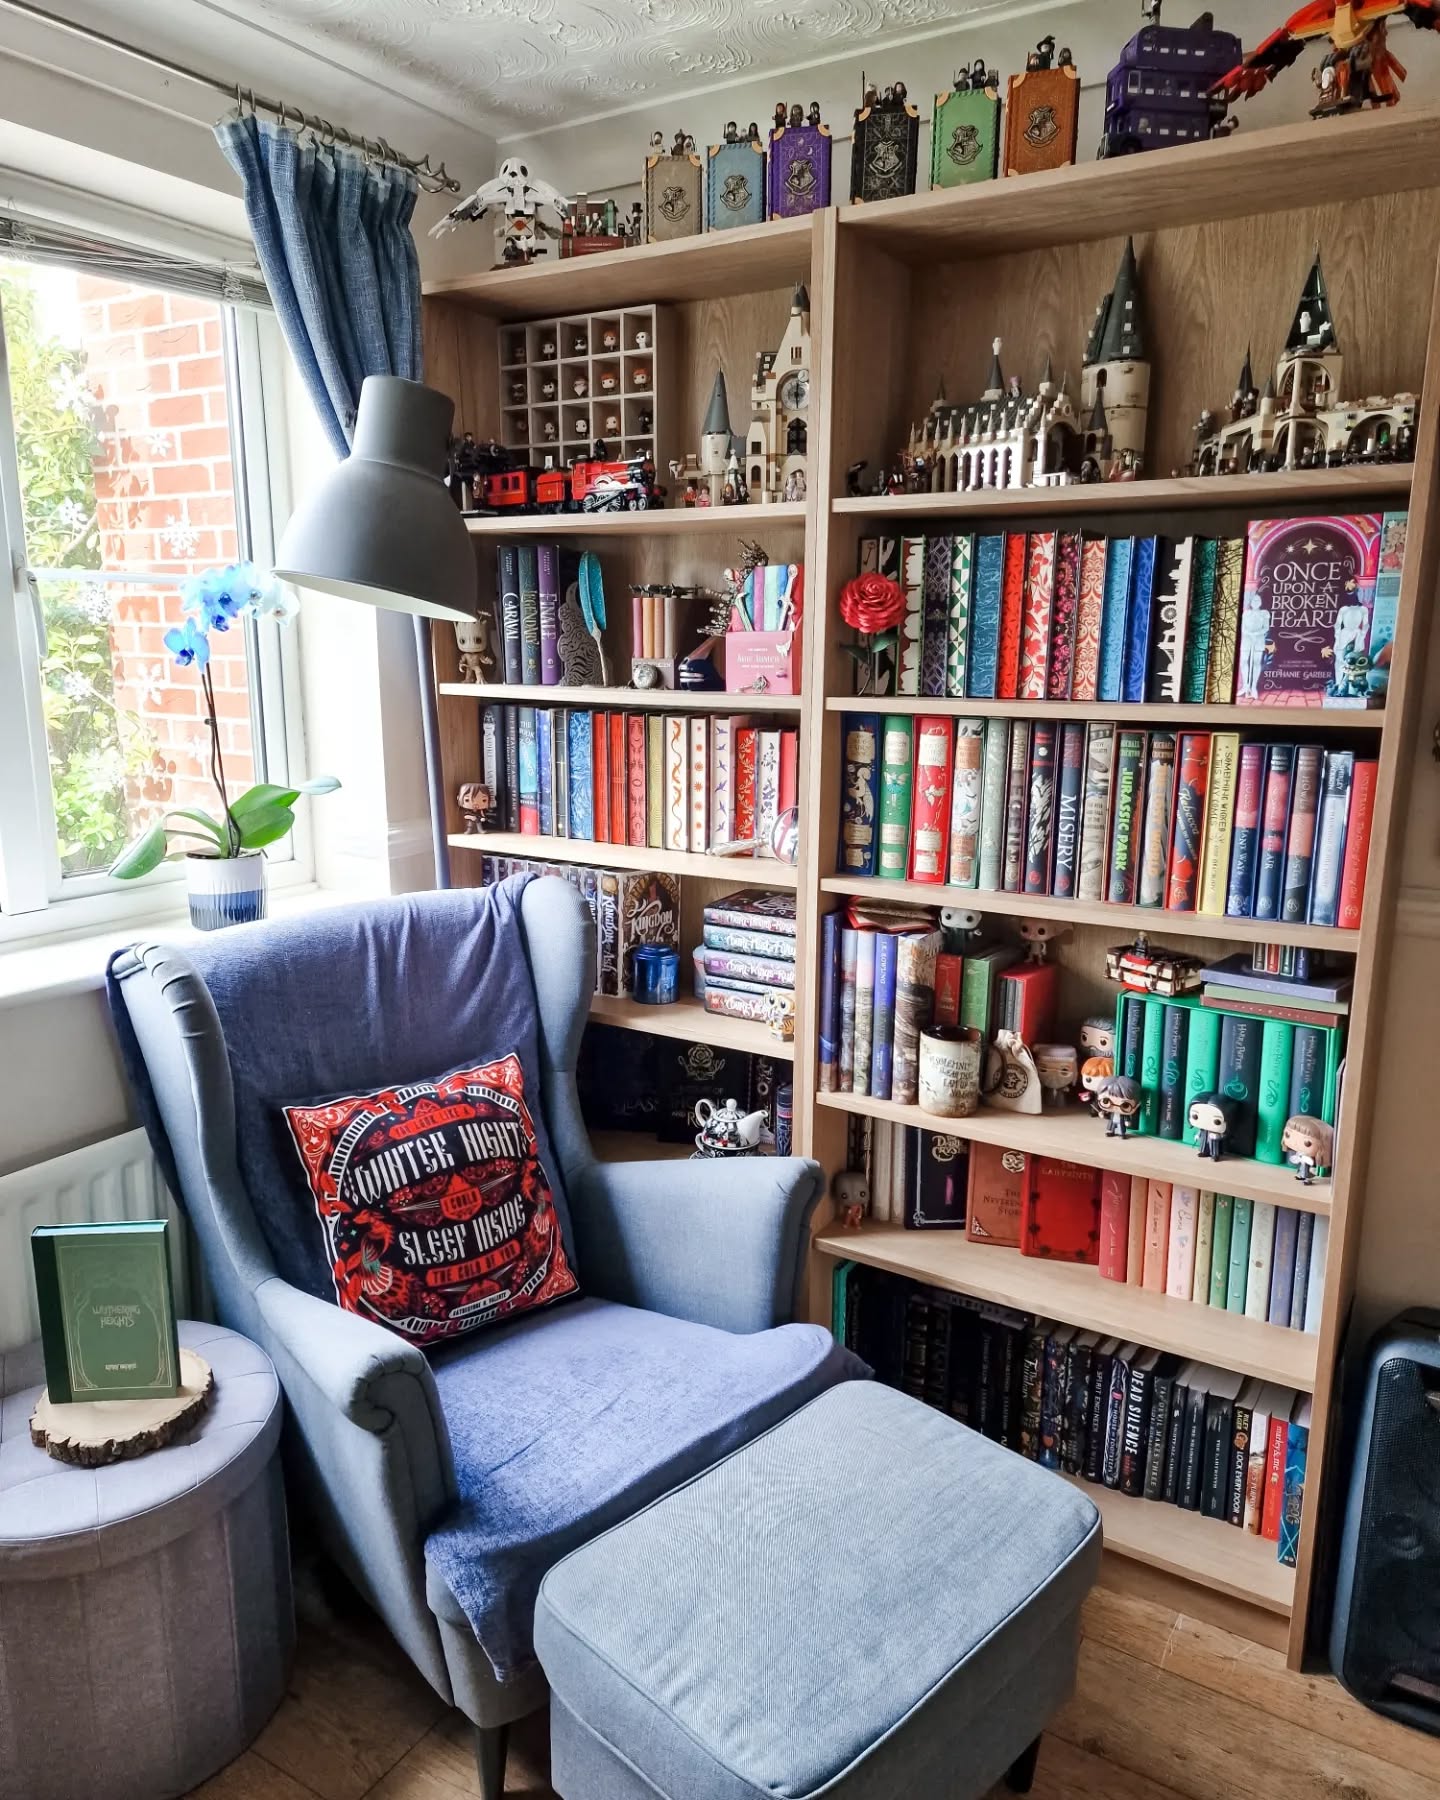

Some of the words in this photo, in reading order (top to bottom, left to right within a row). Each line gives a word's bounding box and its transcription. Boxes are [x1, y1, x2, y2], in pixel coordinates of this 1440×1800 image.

[1274, 562, 1342, 581] ONCE
[1273, 582, 1316, 594] UPON
[1320, 582, 1338, 593] A
[539, 590, 557, 640] FINALE
[1271, 594, 1339, 612] BROKEN
[502, 592, 519, 642] CARAVAL
[521, 591, 540, 645] LEGENDARY
[1270, 610, 1338, 628] HEART
[1264, 669, 1300, 678] STEPHANIE
[1303, 671, 1332, 679] GARBER
[1222, 752, 1233, 801] SOMETHING
[1118, 767, 1133, 831] JURASSIC
[1179, 787, 1199, 835] Rebecca
[1057, 795, 1076, 870] MISERY
[1115, 834, 1129, 871] PARK
[602, 896, 618, 944] KINGDOM
[626, 899, 674, 942] KINGDOM
[879, 952, 887, 985] ROWLING
[415, 1115, 437, 1128] LOOK
[440, 1107, 460, 1120] LIKE
[354, 1131, 455, 1205] WINTER
[458, 1122, 523, 1162] NIGHT
[1042, 1168, 1094, 1180] LABYRINTH
[983, 1196, 1022, 1207] NEVEREN
[998, 1206, 1021, 1216] STOR
[399, 1224, 467, 1266] SLEEP
[472, 1194, 526, 1252] INSIDE
[433, 1270, 452, 1286] THE
[1095, 1371, 1103, 1394] SPIRIT
[1130, 1370, 1144, 1403] DEAD
[1092, 1396, 1101, 1433] ENGINEER
[1111, 1410, 1119, 1431] HOUSE
[1157, 1402, 1165, 1426] DEVIL
[1125, 1404, 1142, 1455] SILENCE
[1154, 1432, 1162, 1457] MAKES
[1236, 1451, 1244, 1470] LOCK
[1151, 1462, 1160, 1487] THREE
[1235, 1471, 1243, 1492] EVERY
[1233, 1493, 1241, 1514] DOOR
